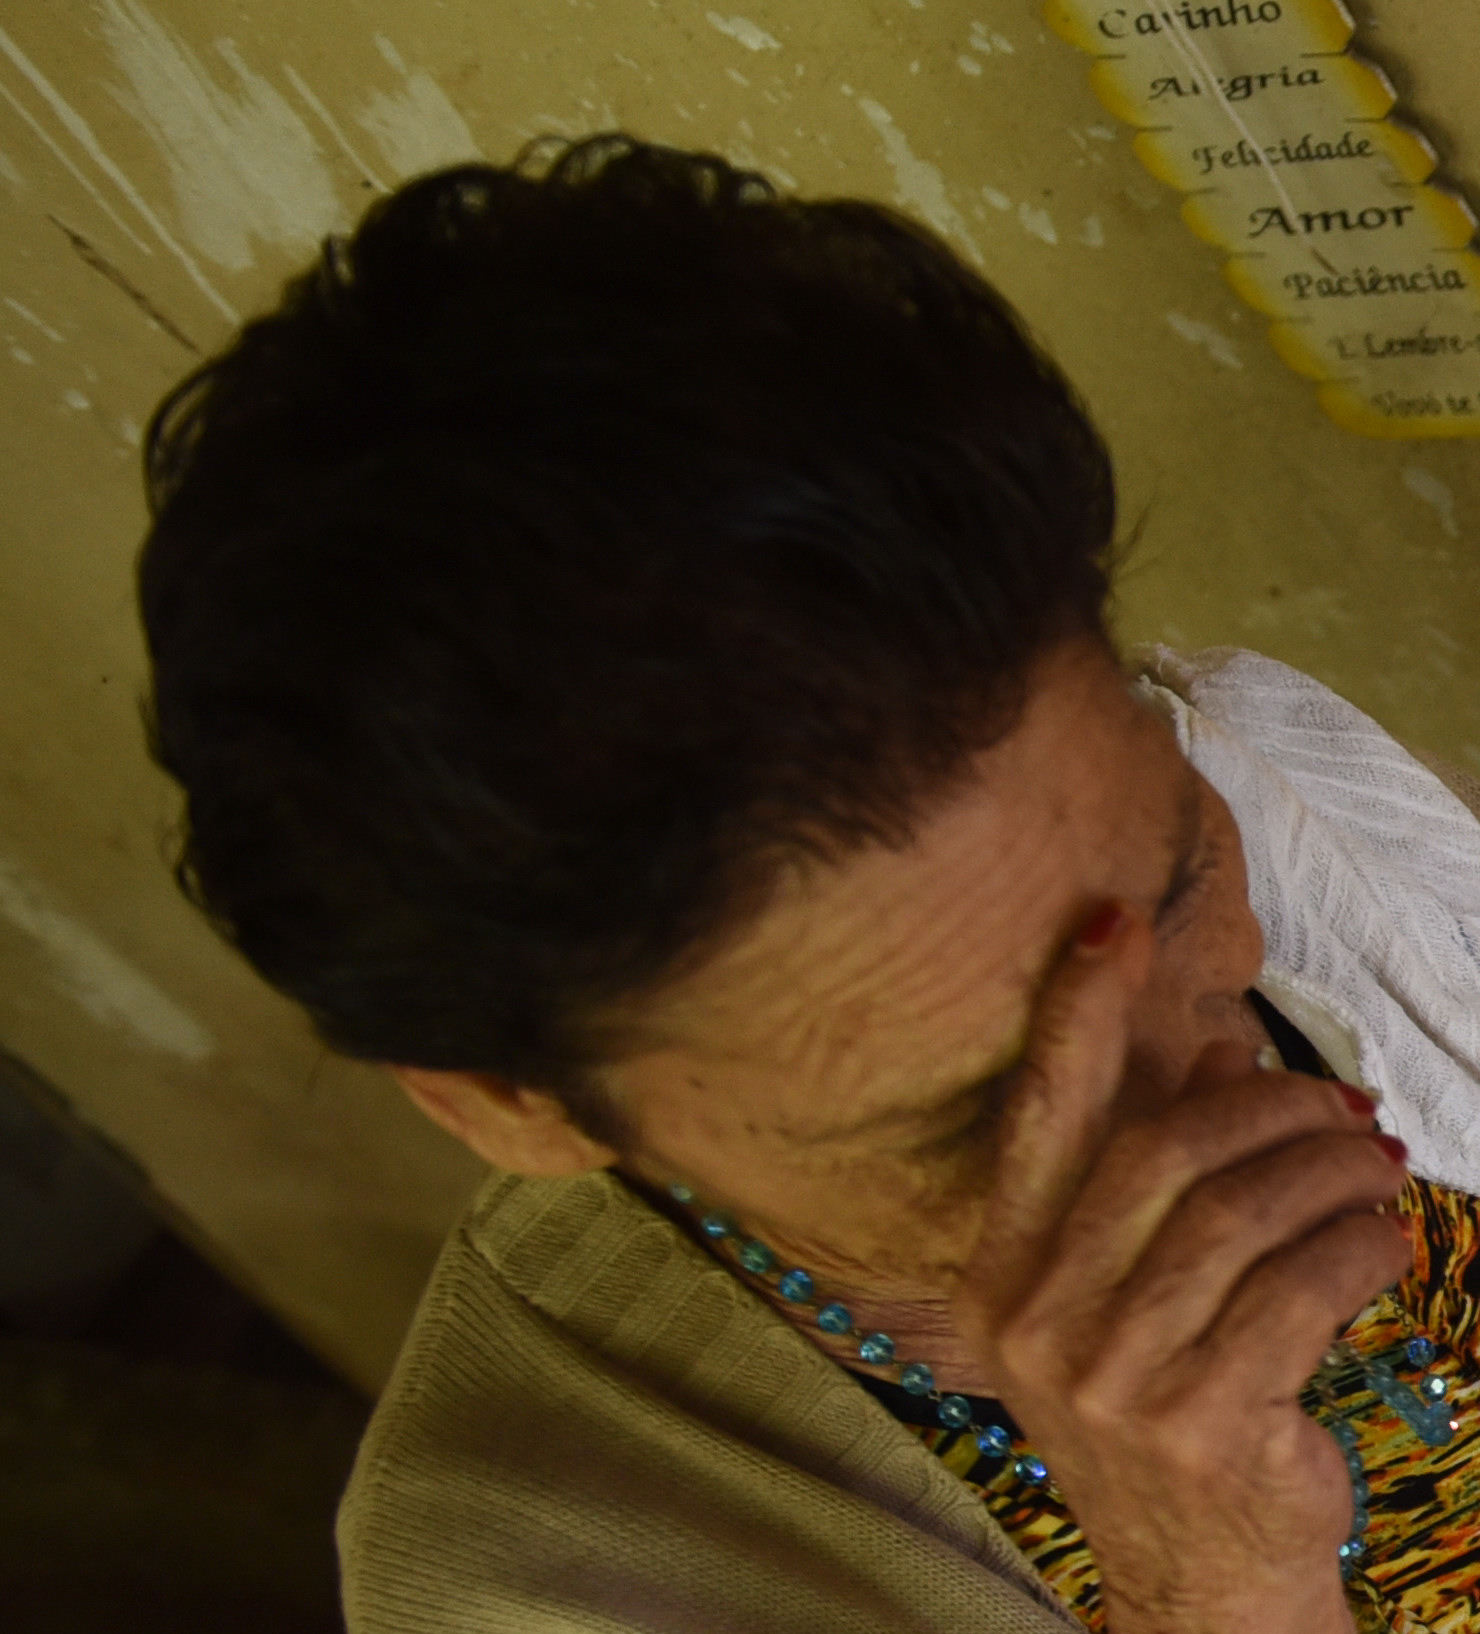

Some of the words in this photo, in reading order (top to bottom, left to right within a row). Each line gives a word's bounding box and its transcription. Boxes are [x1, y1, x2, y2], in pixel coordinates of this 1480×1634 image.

[1147, 65, 1325, 101] Agria
[1247, 205, 1415, 240] Amor
[1282, 264, 1468, 300] Paciência
